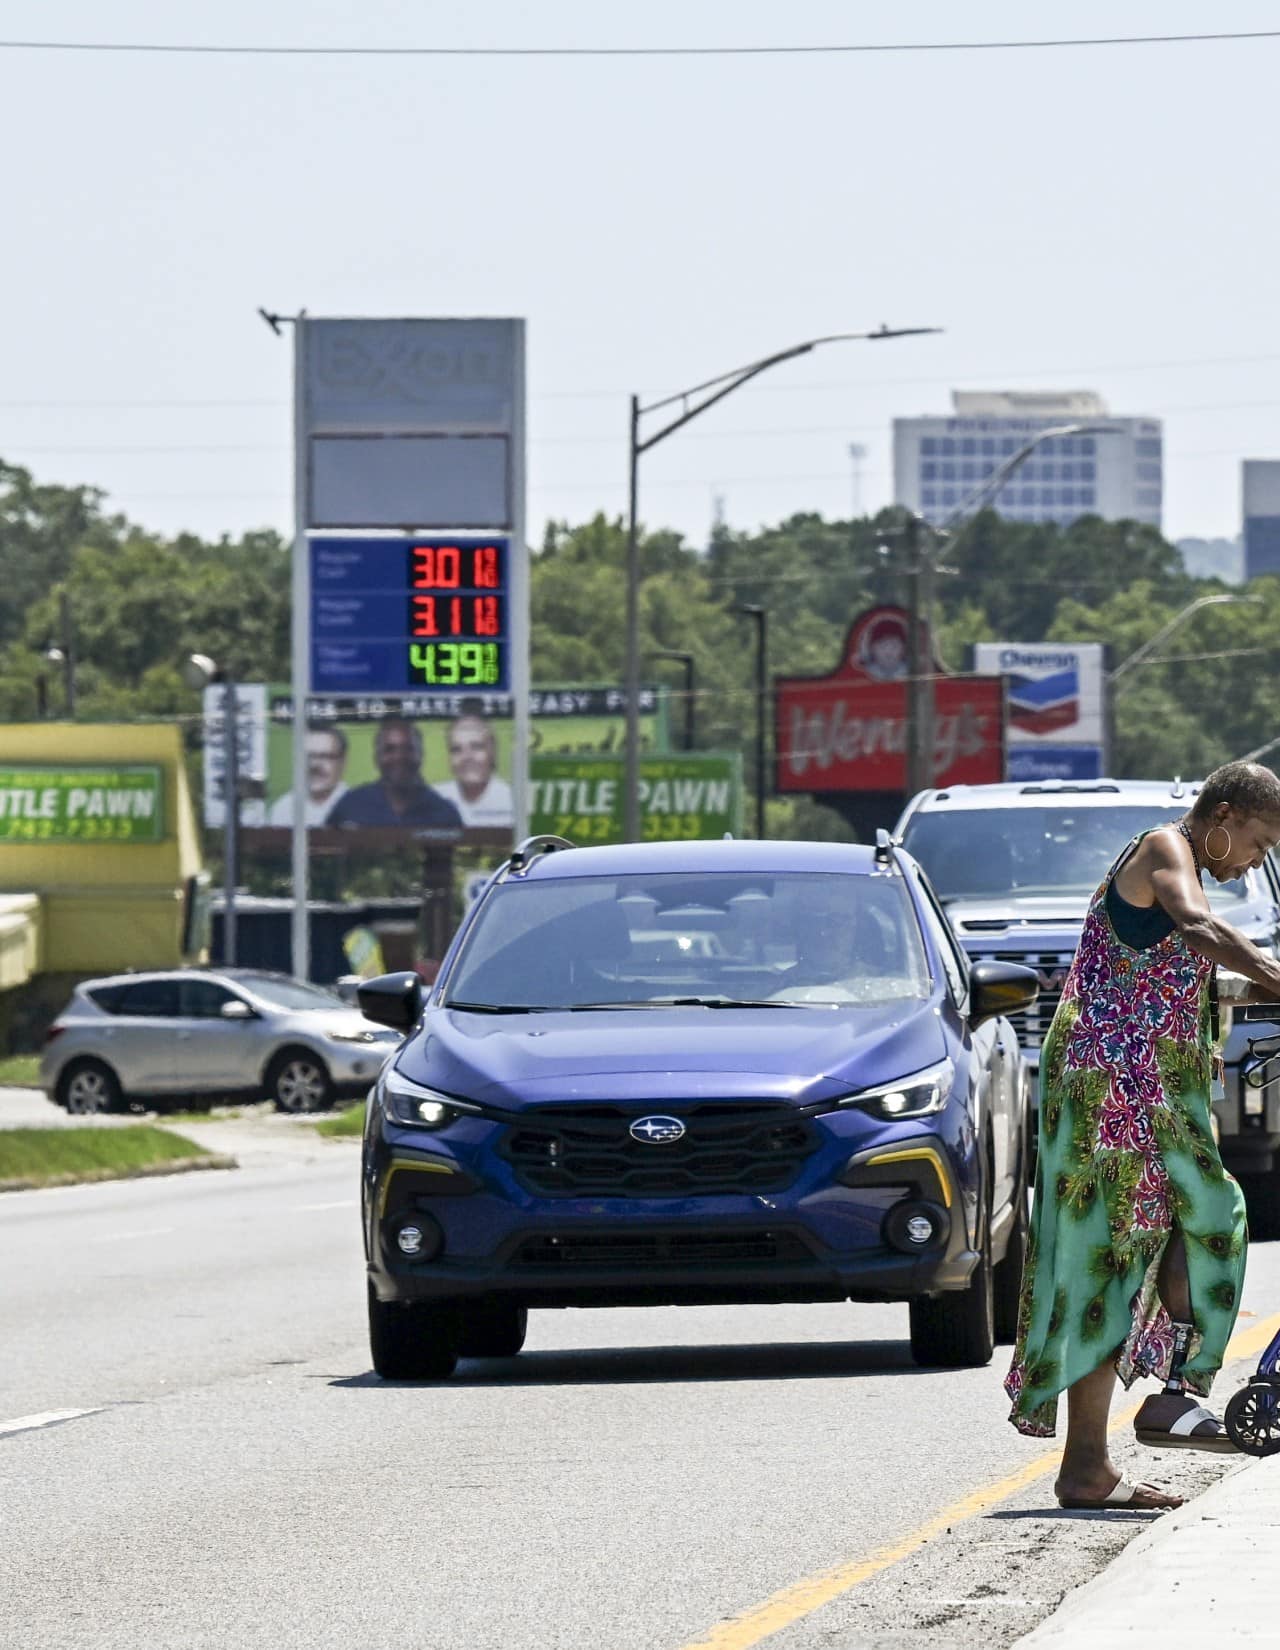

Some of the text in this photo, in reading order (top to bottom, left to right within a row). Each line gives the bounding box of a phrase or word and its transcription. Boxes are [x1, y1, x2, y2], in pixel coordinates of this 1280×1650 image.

[605, 690, 656, 711] FR
[787, 699, 988, 782] Weny's
[66, 787, 155, 818] PAWN
[553, 815, 703, 839] 742-333
